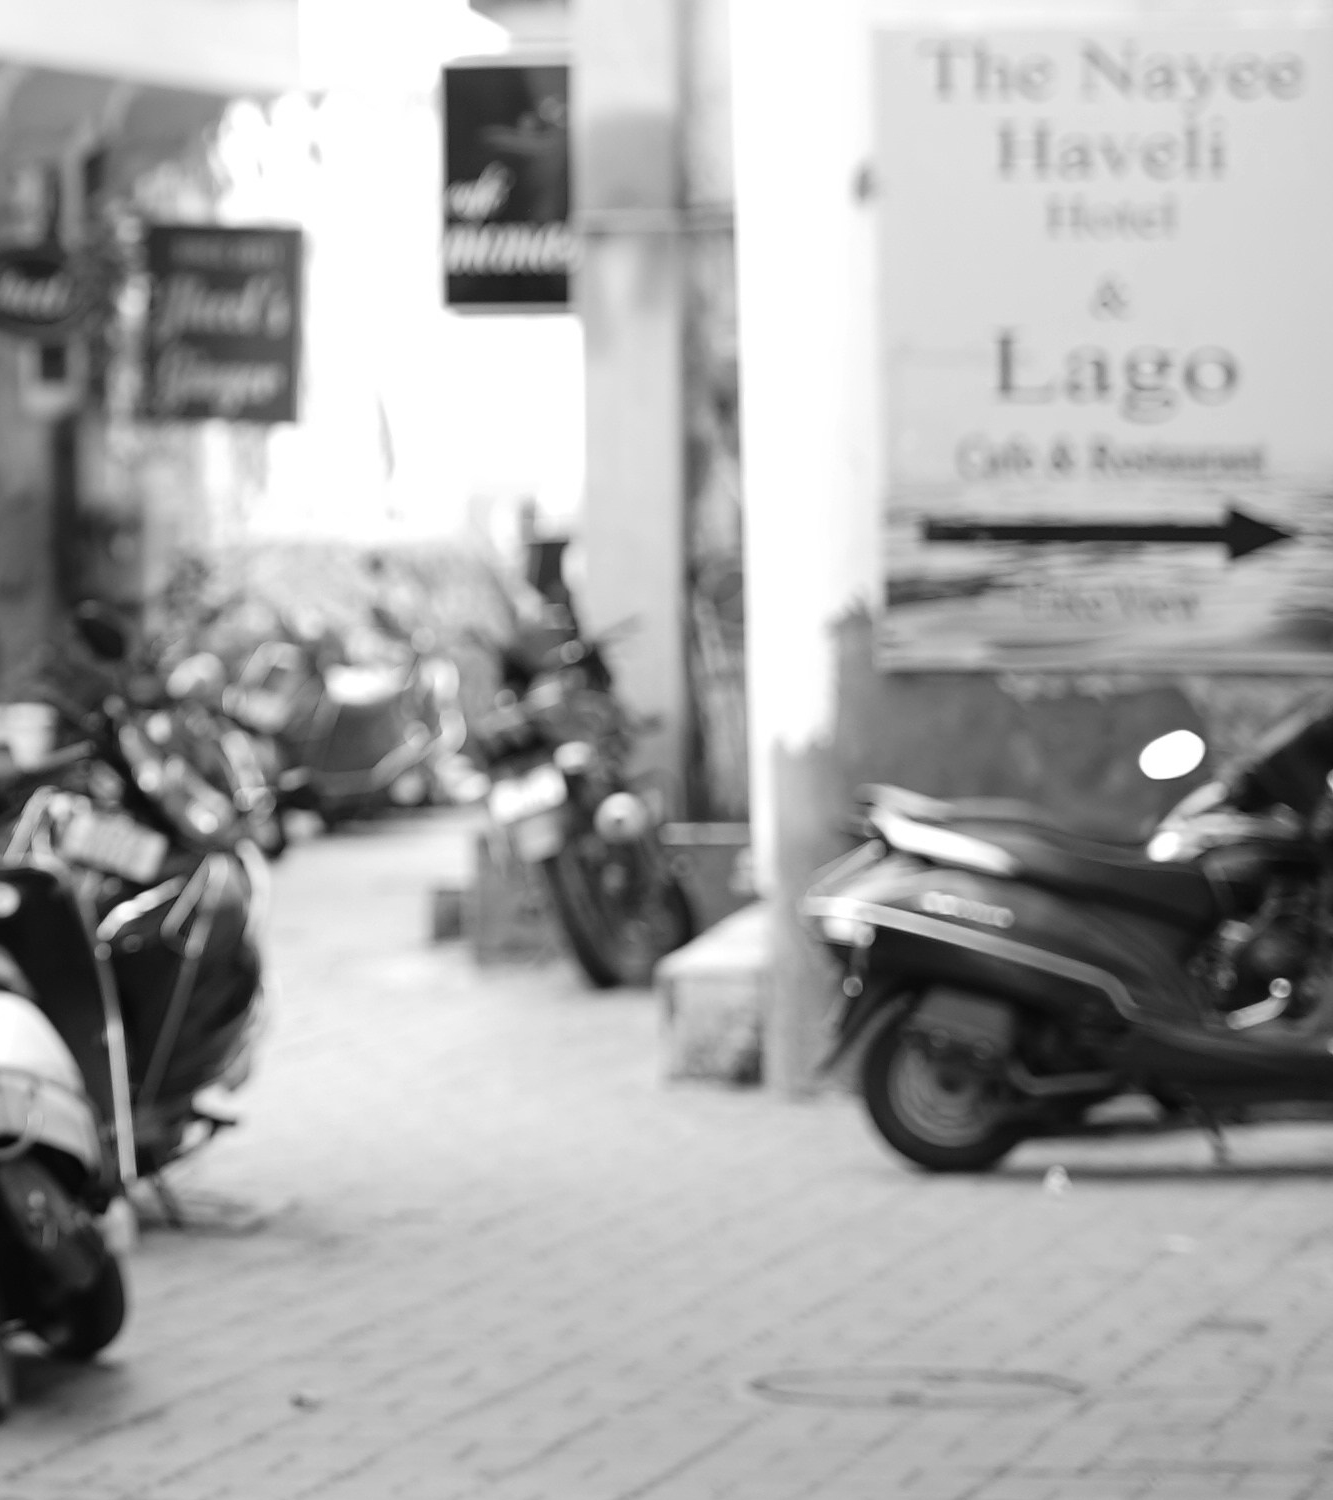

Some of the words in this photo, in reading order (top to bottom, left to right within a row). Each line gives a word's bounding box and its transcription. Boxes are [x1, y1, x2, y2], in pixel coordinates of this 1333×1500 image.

[921, 39, 1056, 101] The
[1079, 39, 1305, 112] Nayee
[996, 116, 1229, 181] Haveli
[1044, 194, 1179, 240] Hotel
[1090, 273, 1132, 319] &
[993, 326, 1241, 424] Lago
